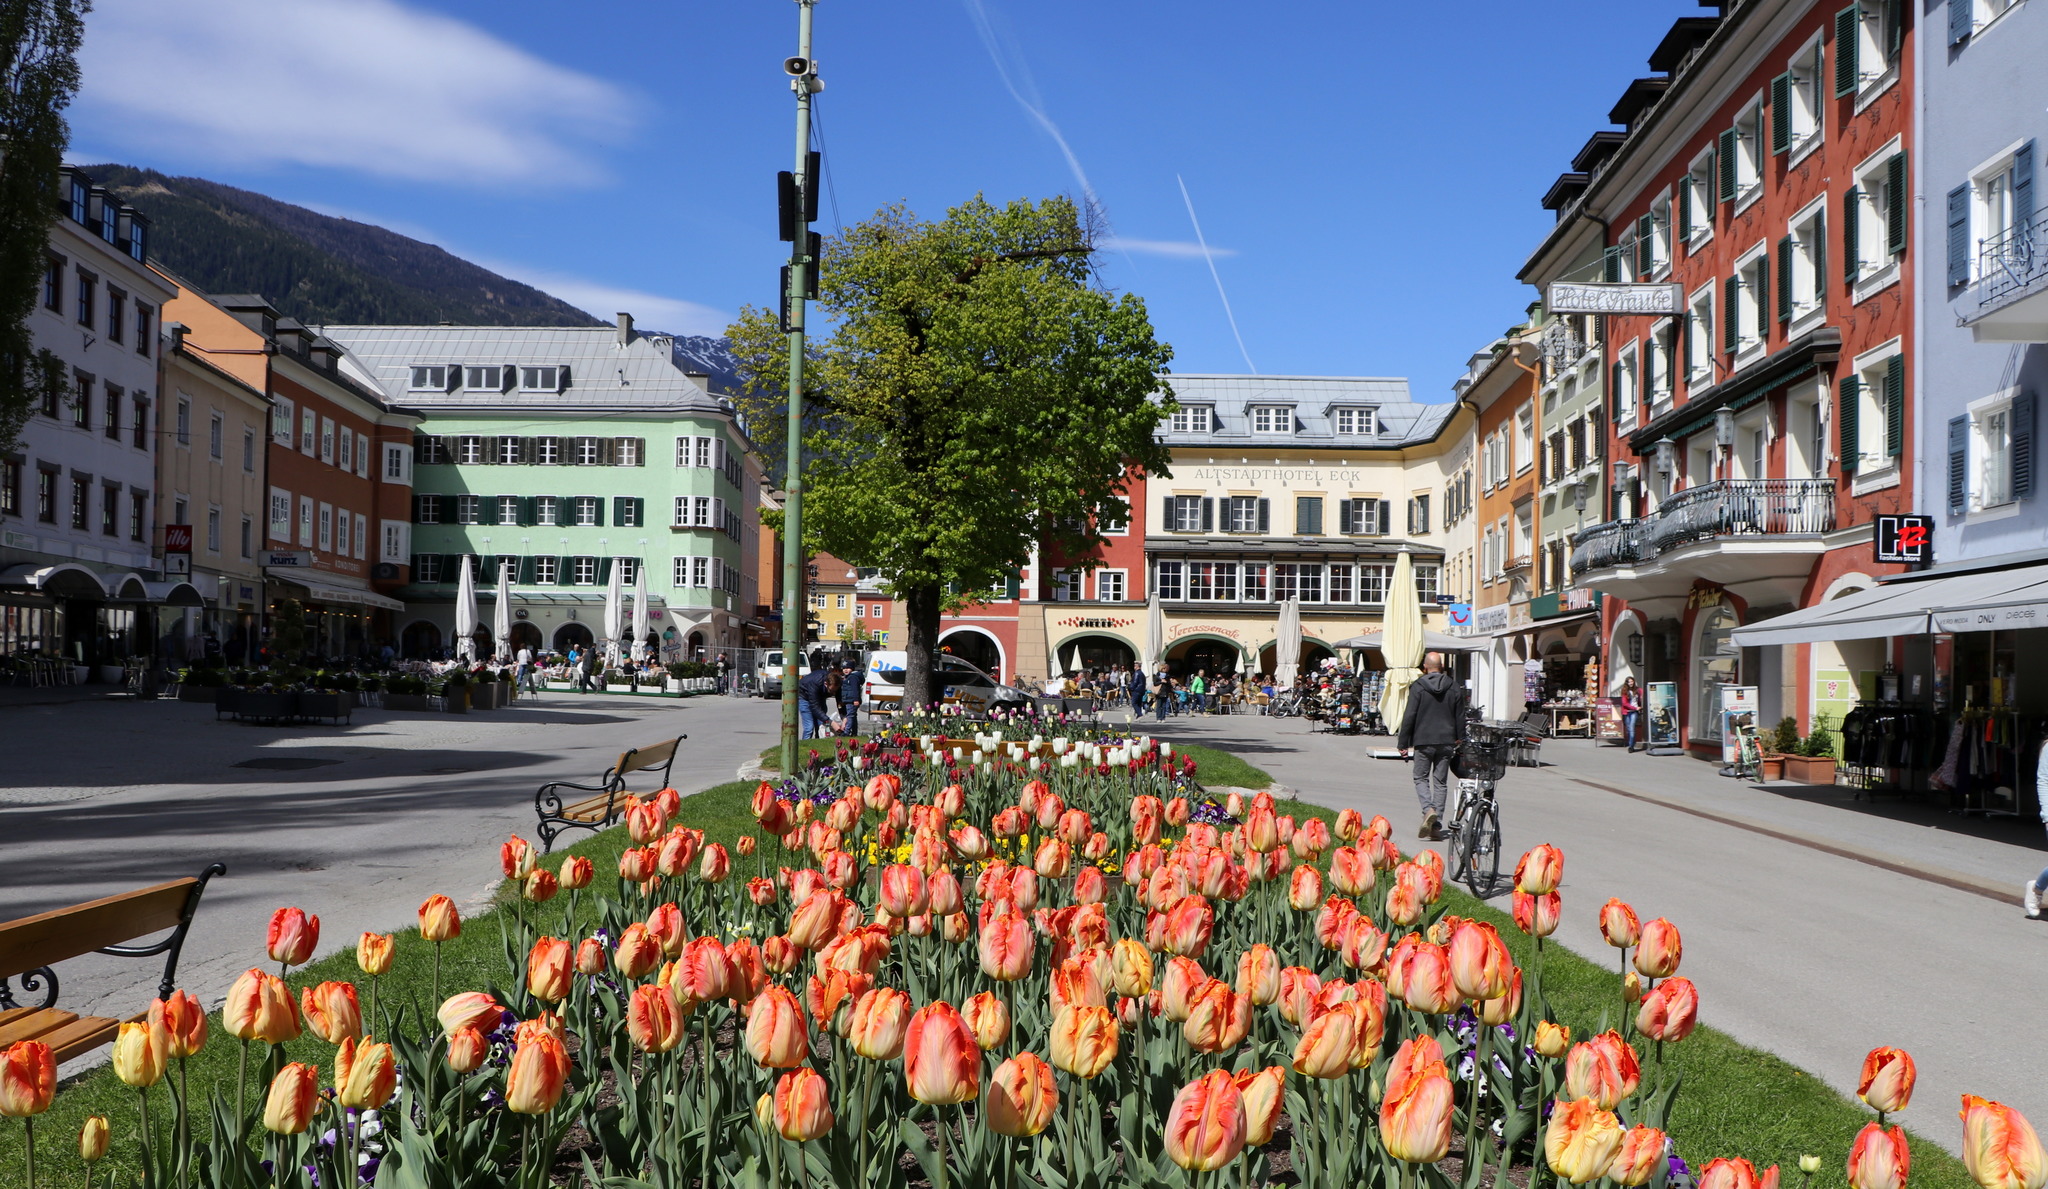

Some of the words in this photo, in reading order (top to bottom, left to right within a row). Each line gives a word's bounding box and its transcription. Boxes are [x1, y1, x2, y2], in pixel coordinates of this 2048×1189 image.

[1194, 468, 1323, 481] ALTSTADTHOTEL
[1330, 470, 1361, 481] ECK
[166, 529, 191, 549] illy
[270, 555, 298, 565] kunz
[1977, 614, 1996, 624] ONLY
[2005, 608, 2036, 620] pieces
[1168, 623, 1240, 640] Terrassencafe
